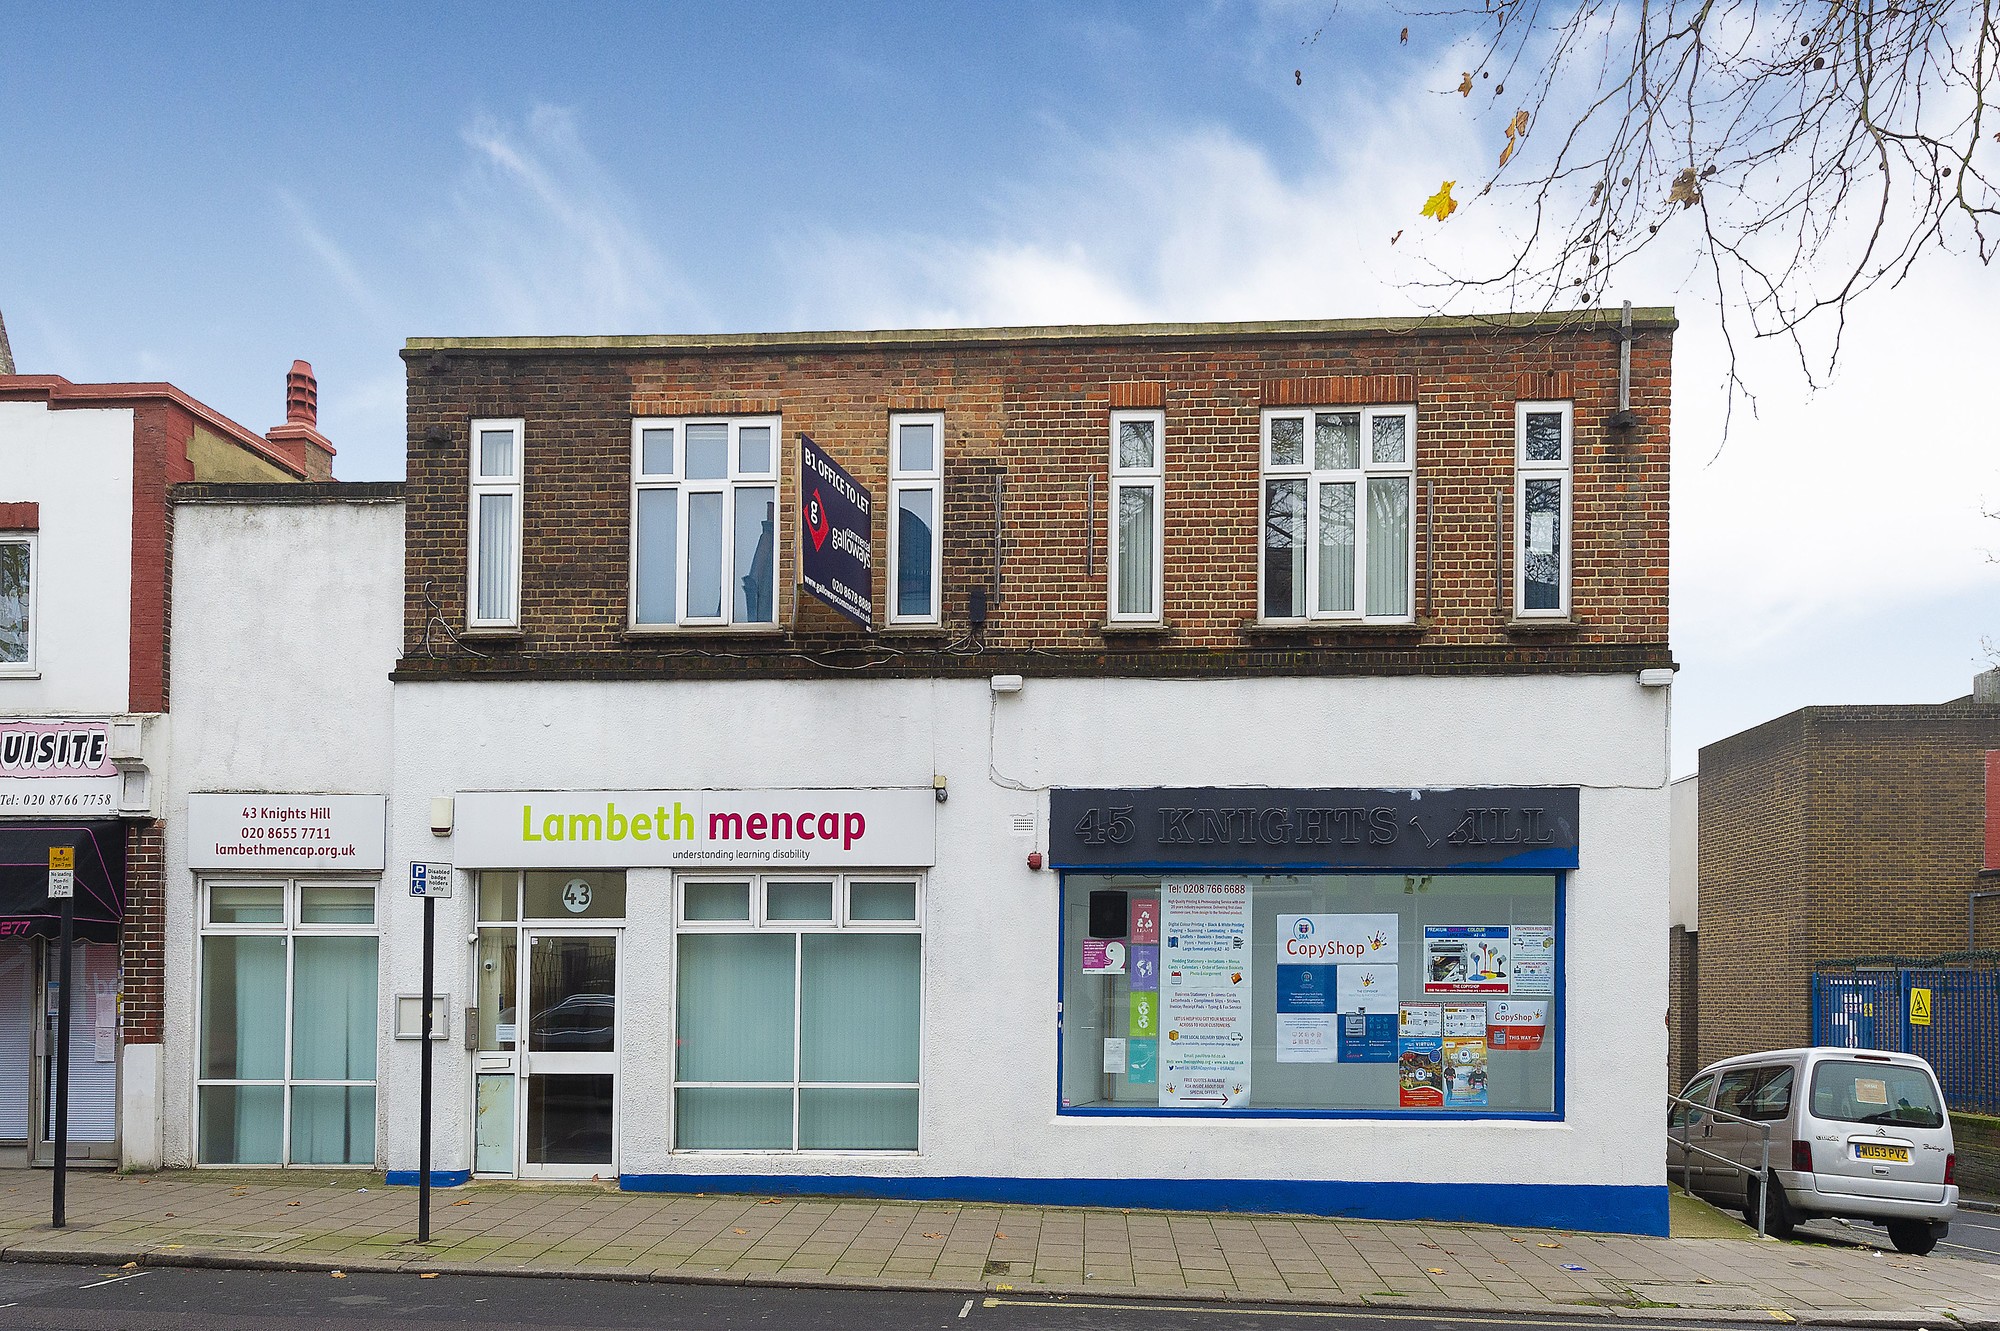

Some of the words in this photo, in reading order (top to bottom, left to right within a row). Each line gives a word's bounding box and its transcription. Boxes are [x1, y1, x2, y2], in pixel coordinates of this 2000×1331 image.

[804, 447, 816, 471] B1
[818, 460, 844, 495] OFFICE
[846, 482, 856, 504] TO
[857, 492, 869, 515] LET
[832, 527, 870, 570] galloways
[846, 528, 870, 553] commercial
[804, 574, 871, 625] www.gallowayscommercial.co.uk
[832, 578, 843, 594] 020
[844, 586, 858, 605] 8678
[858, 596, 872, 614] 8888
[0, 794, 20, 806] Tel:
[24, 794, 46, 806] 020
[50, 794, 78, 806] 8766
[83, 794, 112, 806] 7758
[242, 807, 258, 819] 43
[260, 807, 307, 822] Knights
[310, 807, 331, 820] Hill
[522, 802, 695, 842] Lambeth
[709, 812, 866, 850] mencap
[1074, 806, 1136, 844] 45
[1157, 806, 1400, 844] KNIGHTS
[241, 828, 264, 840] 020
[267, 828, 298, 840] 8655
[301, 828, 331, 840] 7711
[215, 843, 356, 858] lambethmencap.org.uk
[672, 850, 734, 862] understanding
[736, 850, 770, 862] learning
[772, 850, 811, 862] disability
[416, 866, 424, 878] P
[564, 884, 590, 906] 43
[1168, 884, 1182, 894] Tel:
[1183, 884, 1204, 894] 0208
[1206, 884, 1222, 894] 766
[1224, 884, 1246, 894] 6688
[1286, 939, 1365, 958] CopyShop
[1494, 1012, 1532, 1022] CopyShop
[1861, 1145, 1886, 1158] WU53
[1889, 1148, 1908, 1160] PVZ
